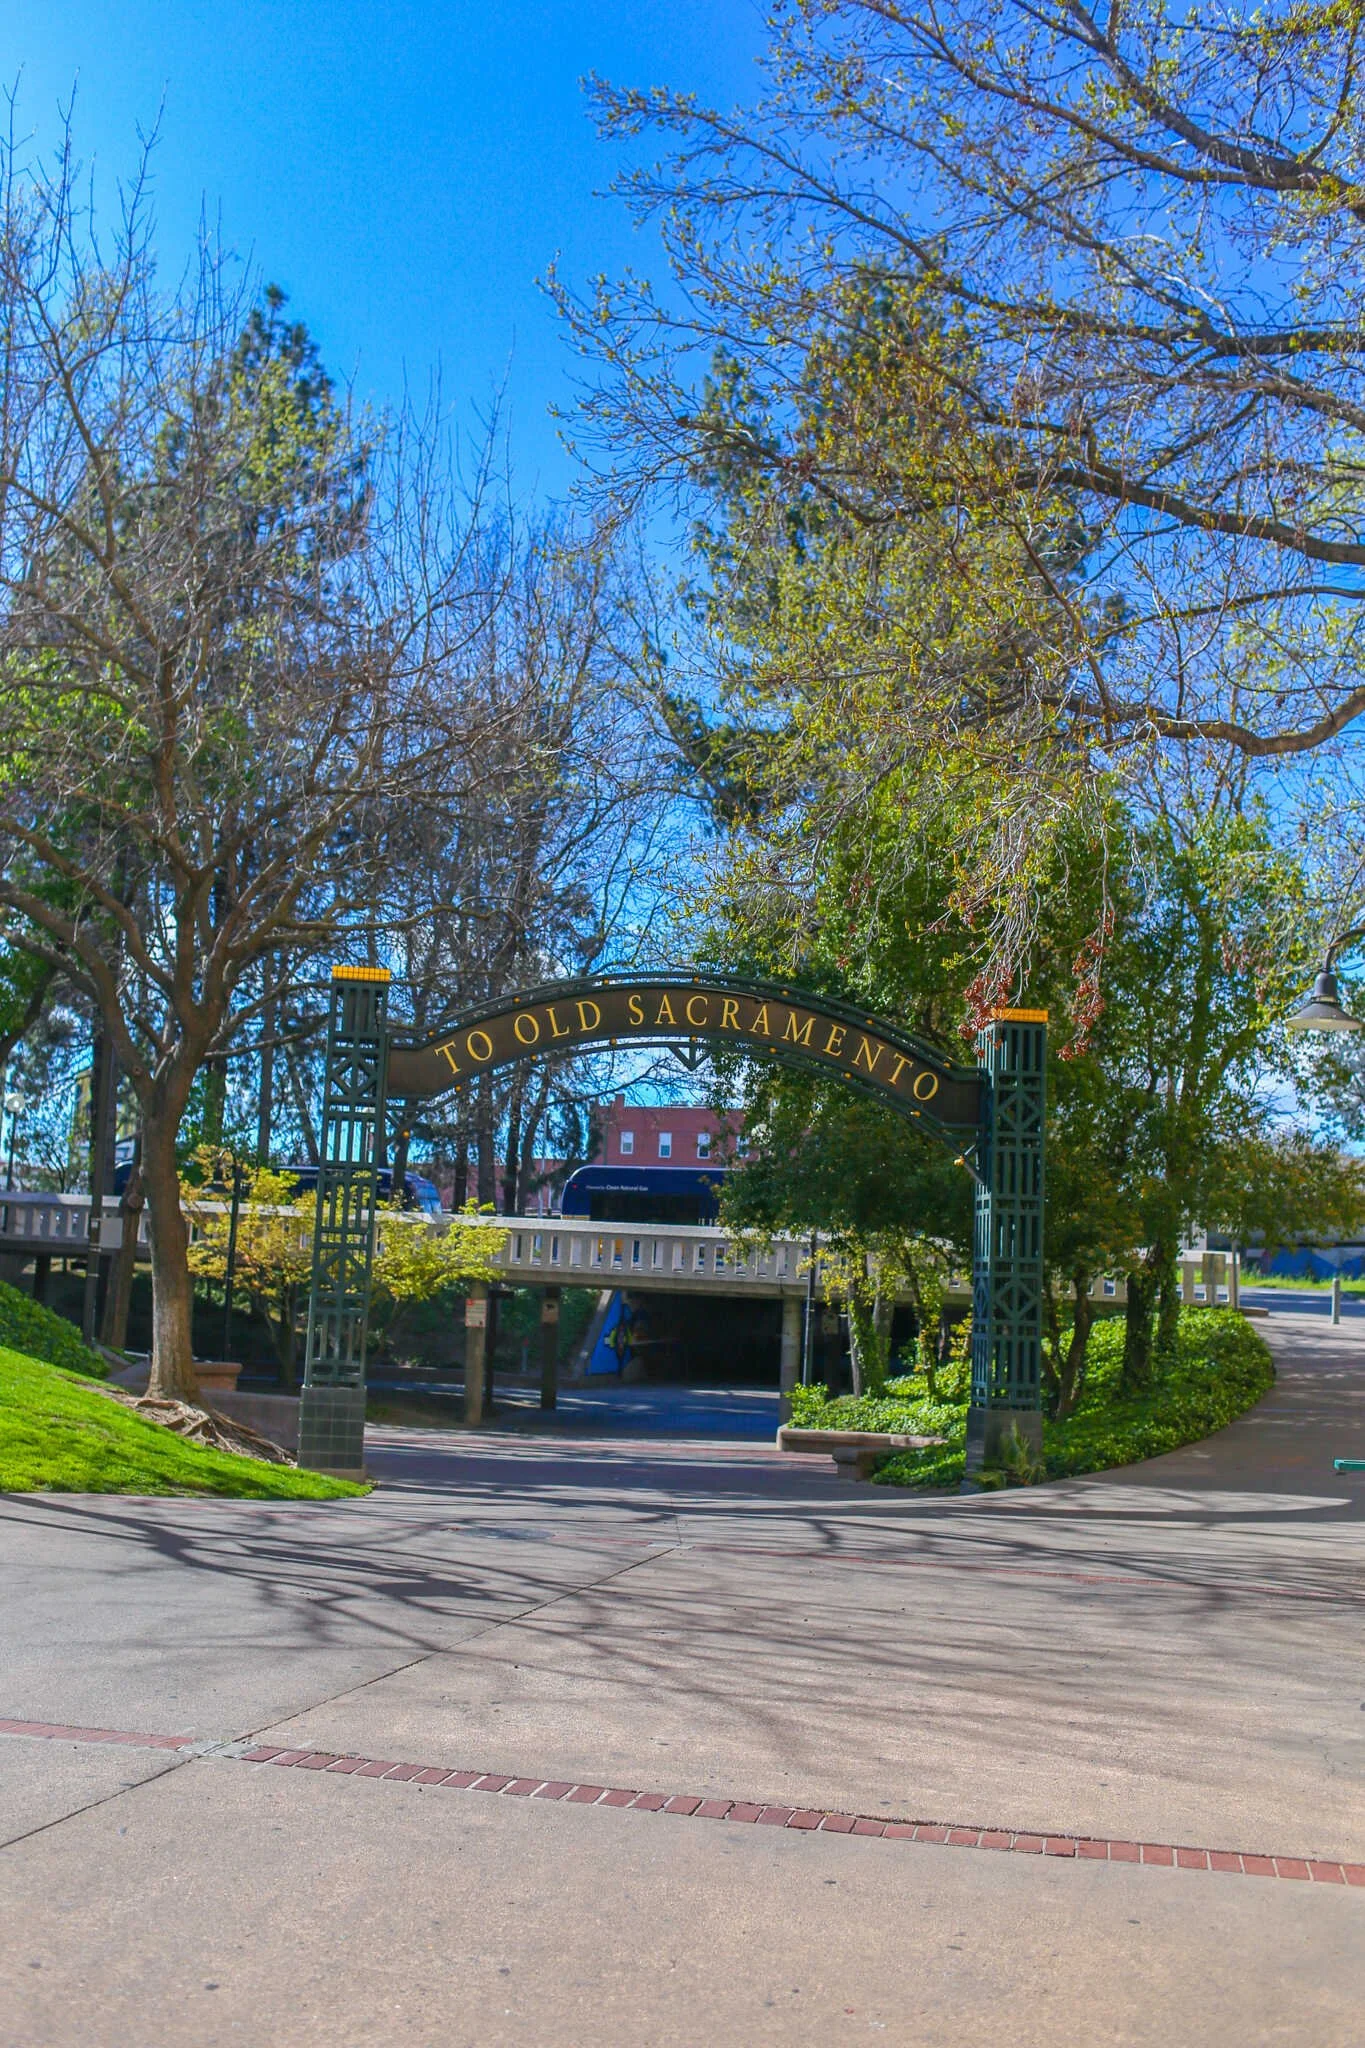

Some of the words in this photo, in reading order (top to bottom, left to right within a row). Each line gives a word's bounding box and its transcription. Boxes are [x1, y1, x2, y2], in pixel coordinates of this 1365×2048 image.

[434, 1030, 493, 1075] TO
[514, 1000, 601, 1045] OLD
[628, 993, 939, 1101] SACRAMENTO
